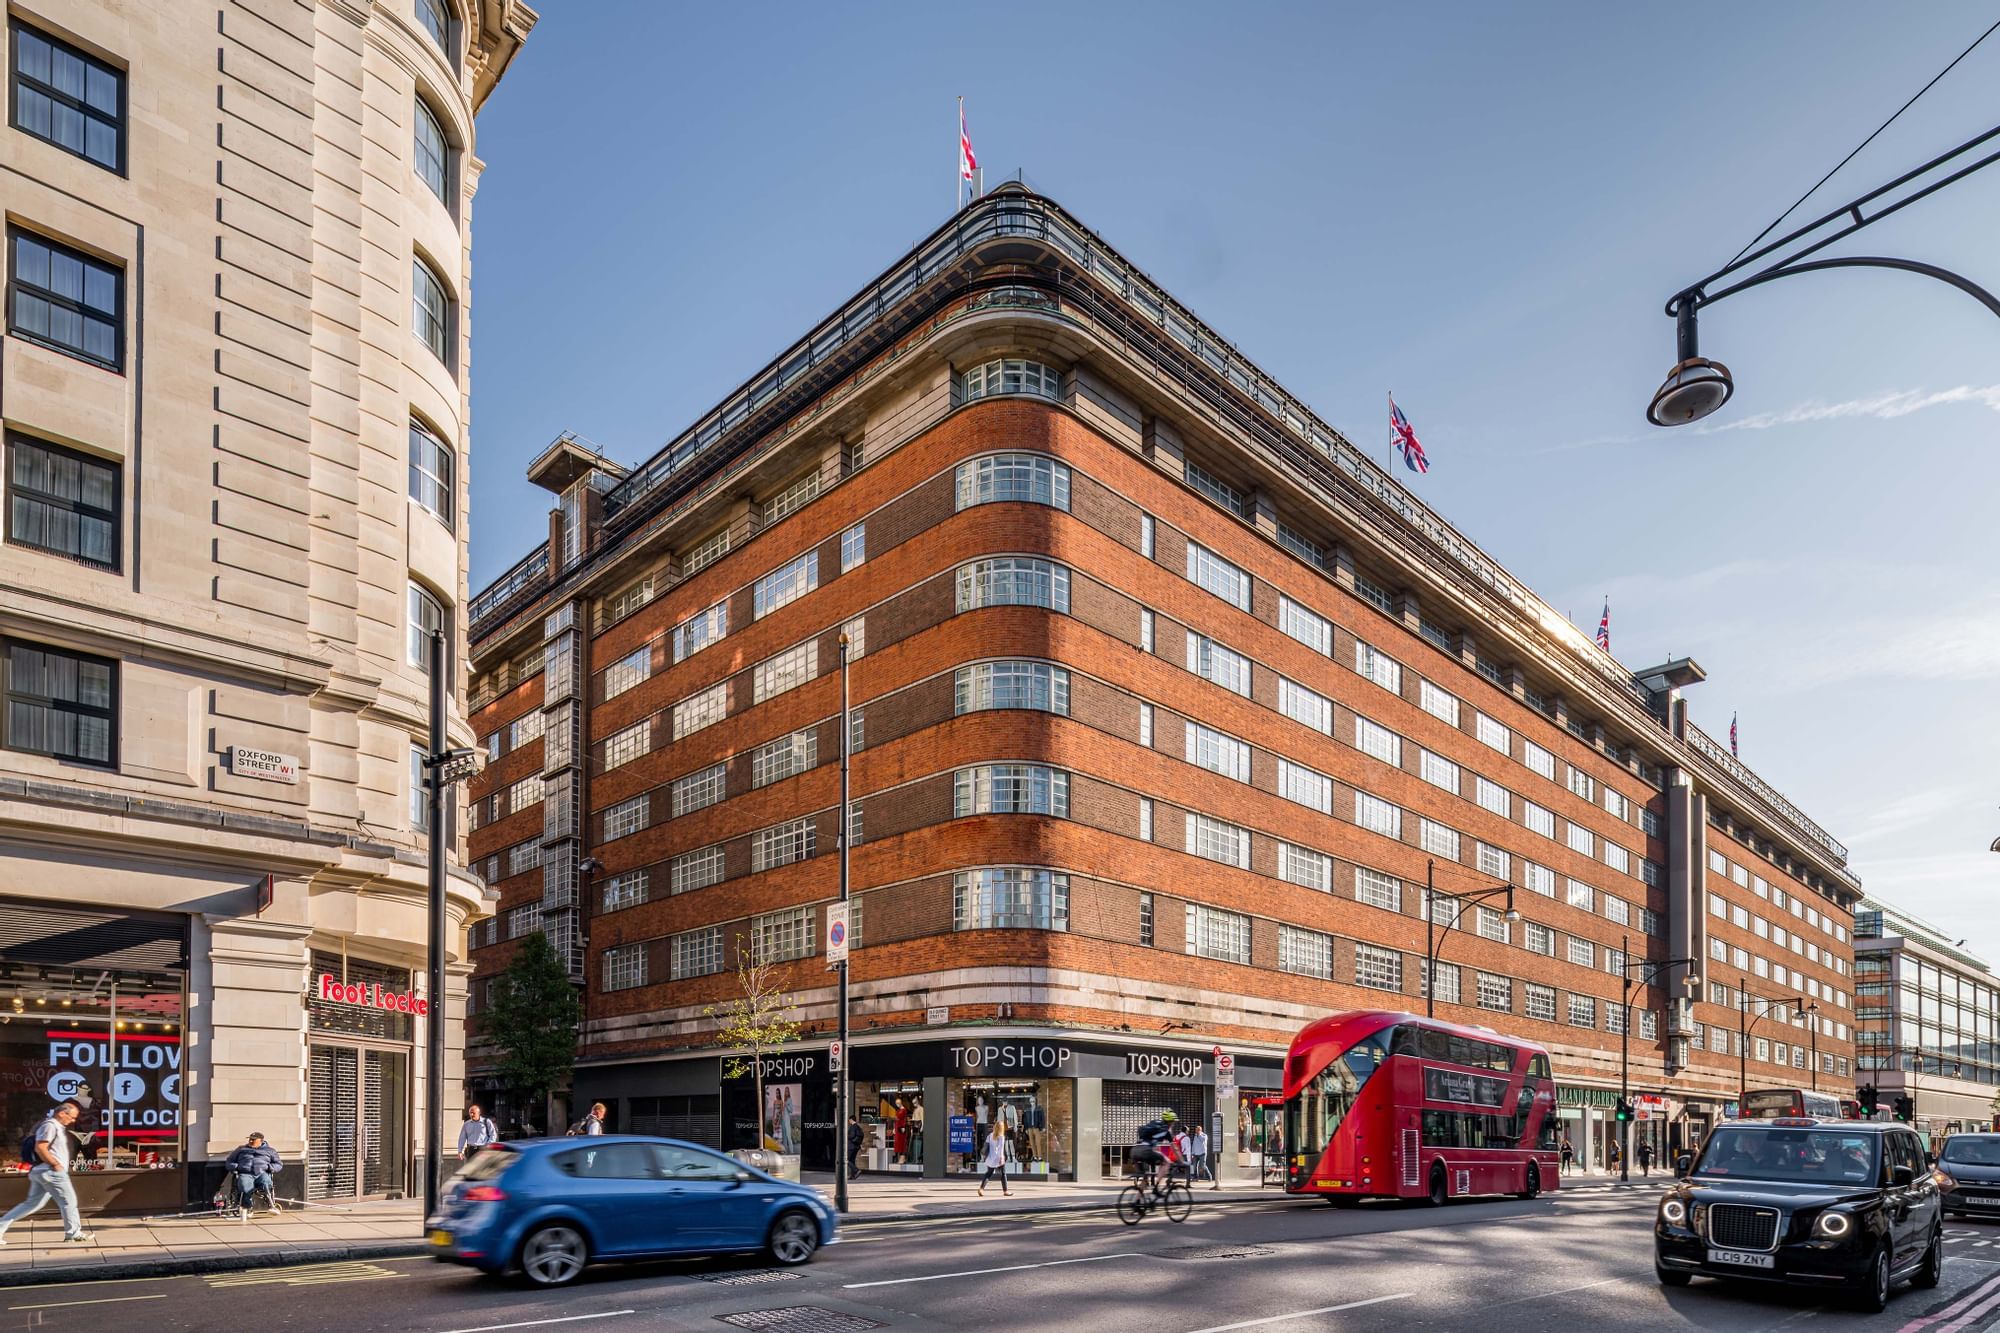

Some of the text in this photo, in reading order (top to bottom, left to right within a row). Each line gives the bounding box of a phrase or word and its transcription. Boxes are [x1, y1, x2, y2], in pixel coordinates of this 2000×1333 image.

[238, 749, 282, 764] OXFORD
[238, 758, 277, 771] STREET
[258, 772, 291, 781] WESTMINSTER
[321, 973, 428, 1016] Foot Locke
[950, 1046, 1071, 1068] TOPSHOP
[1127, 1053, 1202, 1077] TOPSHOP
[748, 1057, 815, 1079] TOPSHOP
[1715, 1251, 1766, 1265] LC19 ZNY
